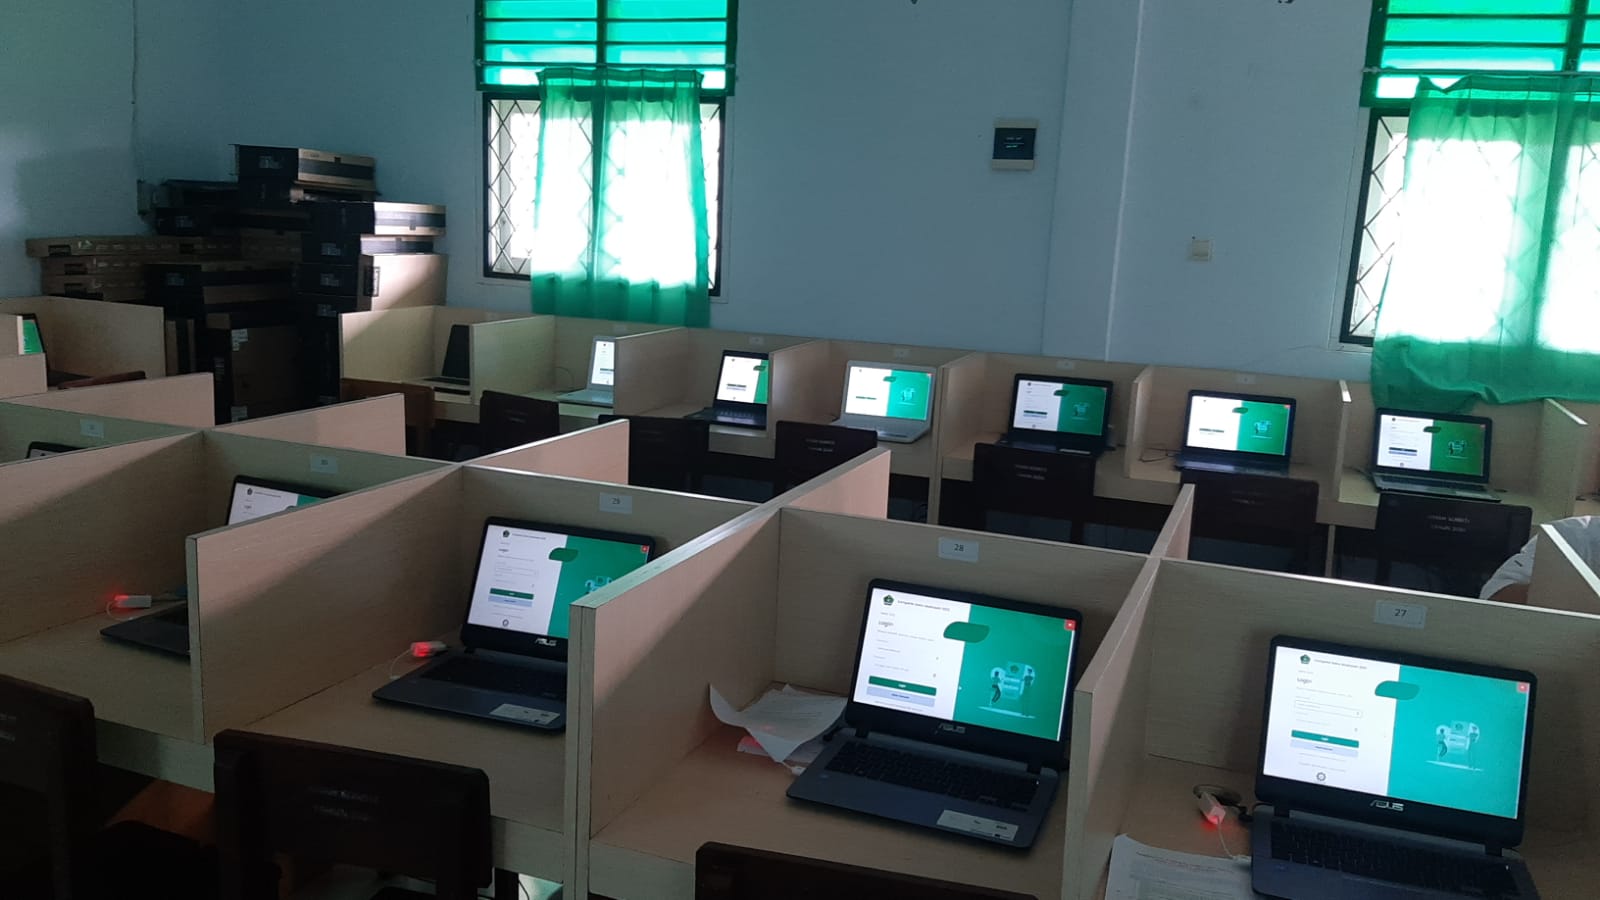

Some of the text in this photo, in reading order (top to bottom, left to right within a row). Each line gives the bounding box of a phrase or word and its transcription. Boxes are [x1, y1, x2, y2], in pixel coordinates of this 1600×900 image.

[954, 543, 964, 552] 28
[1394, 608, 1407, 617] 27
[534, 637, 557, 647] ASUS
[938, 722, 966, 734] ASUS
[1370, 799, 1404, 812] ASUS
